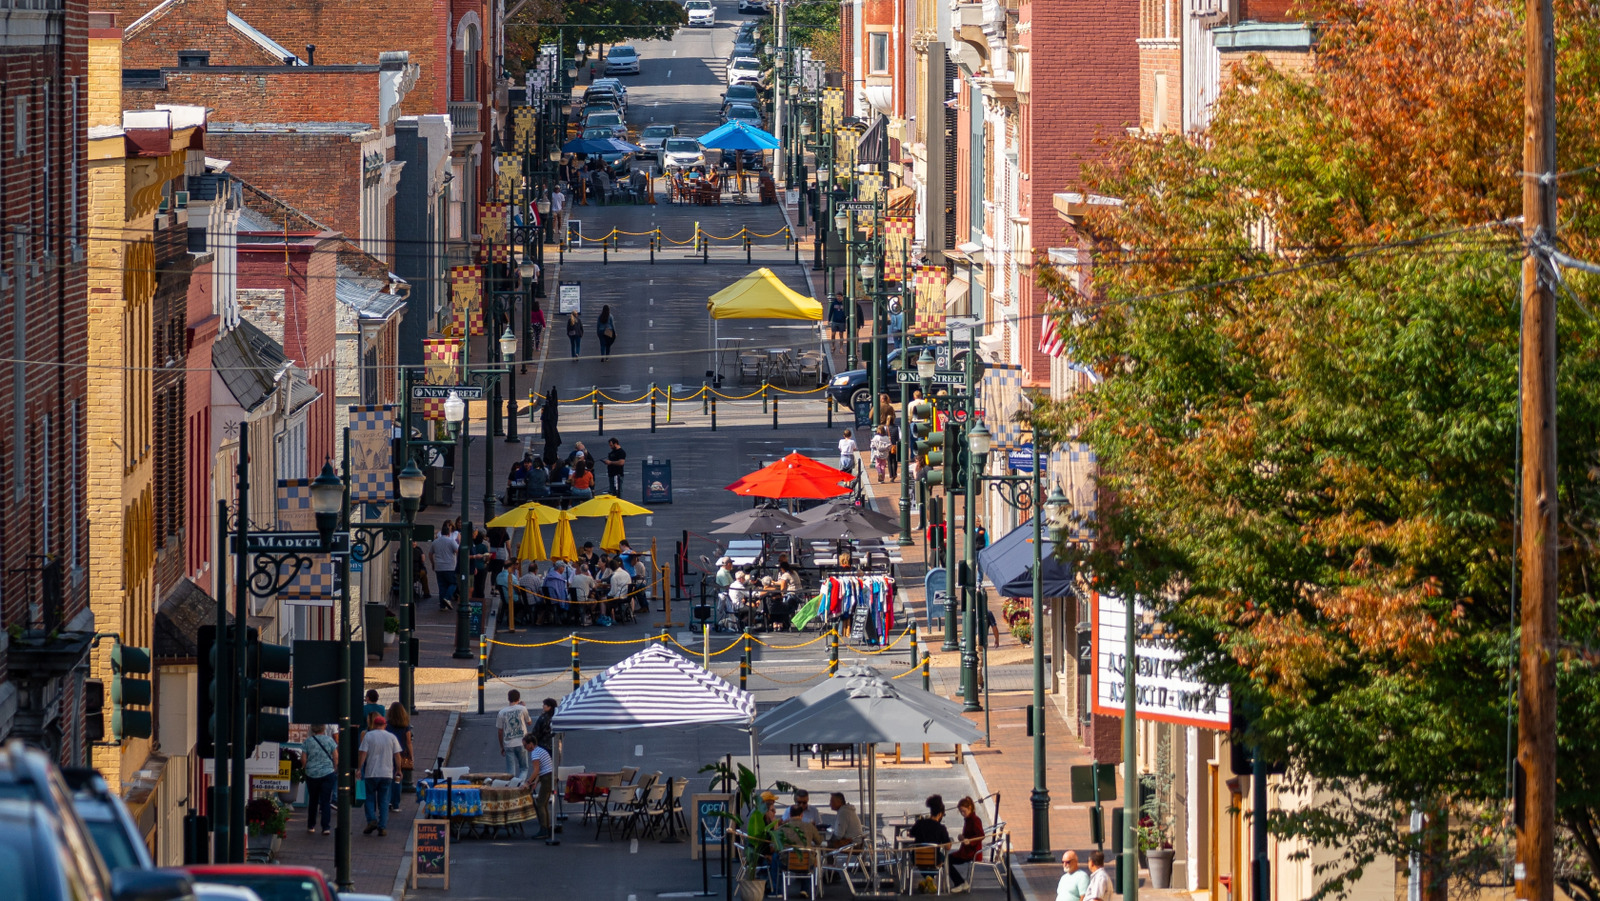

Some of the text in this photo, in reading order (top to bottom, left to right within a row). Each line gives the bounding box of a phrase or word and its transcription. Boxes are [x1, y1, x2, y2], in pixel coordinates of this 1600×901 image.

[932, 373, 963, 383] STREET
[424, 388, 445, 397] NEW
[418, 832, 438, 840] SHOPPE
[417, 845, 444, 853] CRYSTALS
